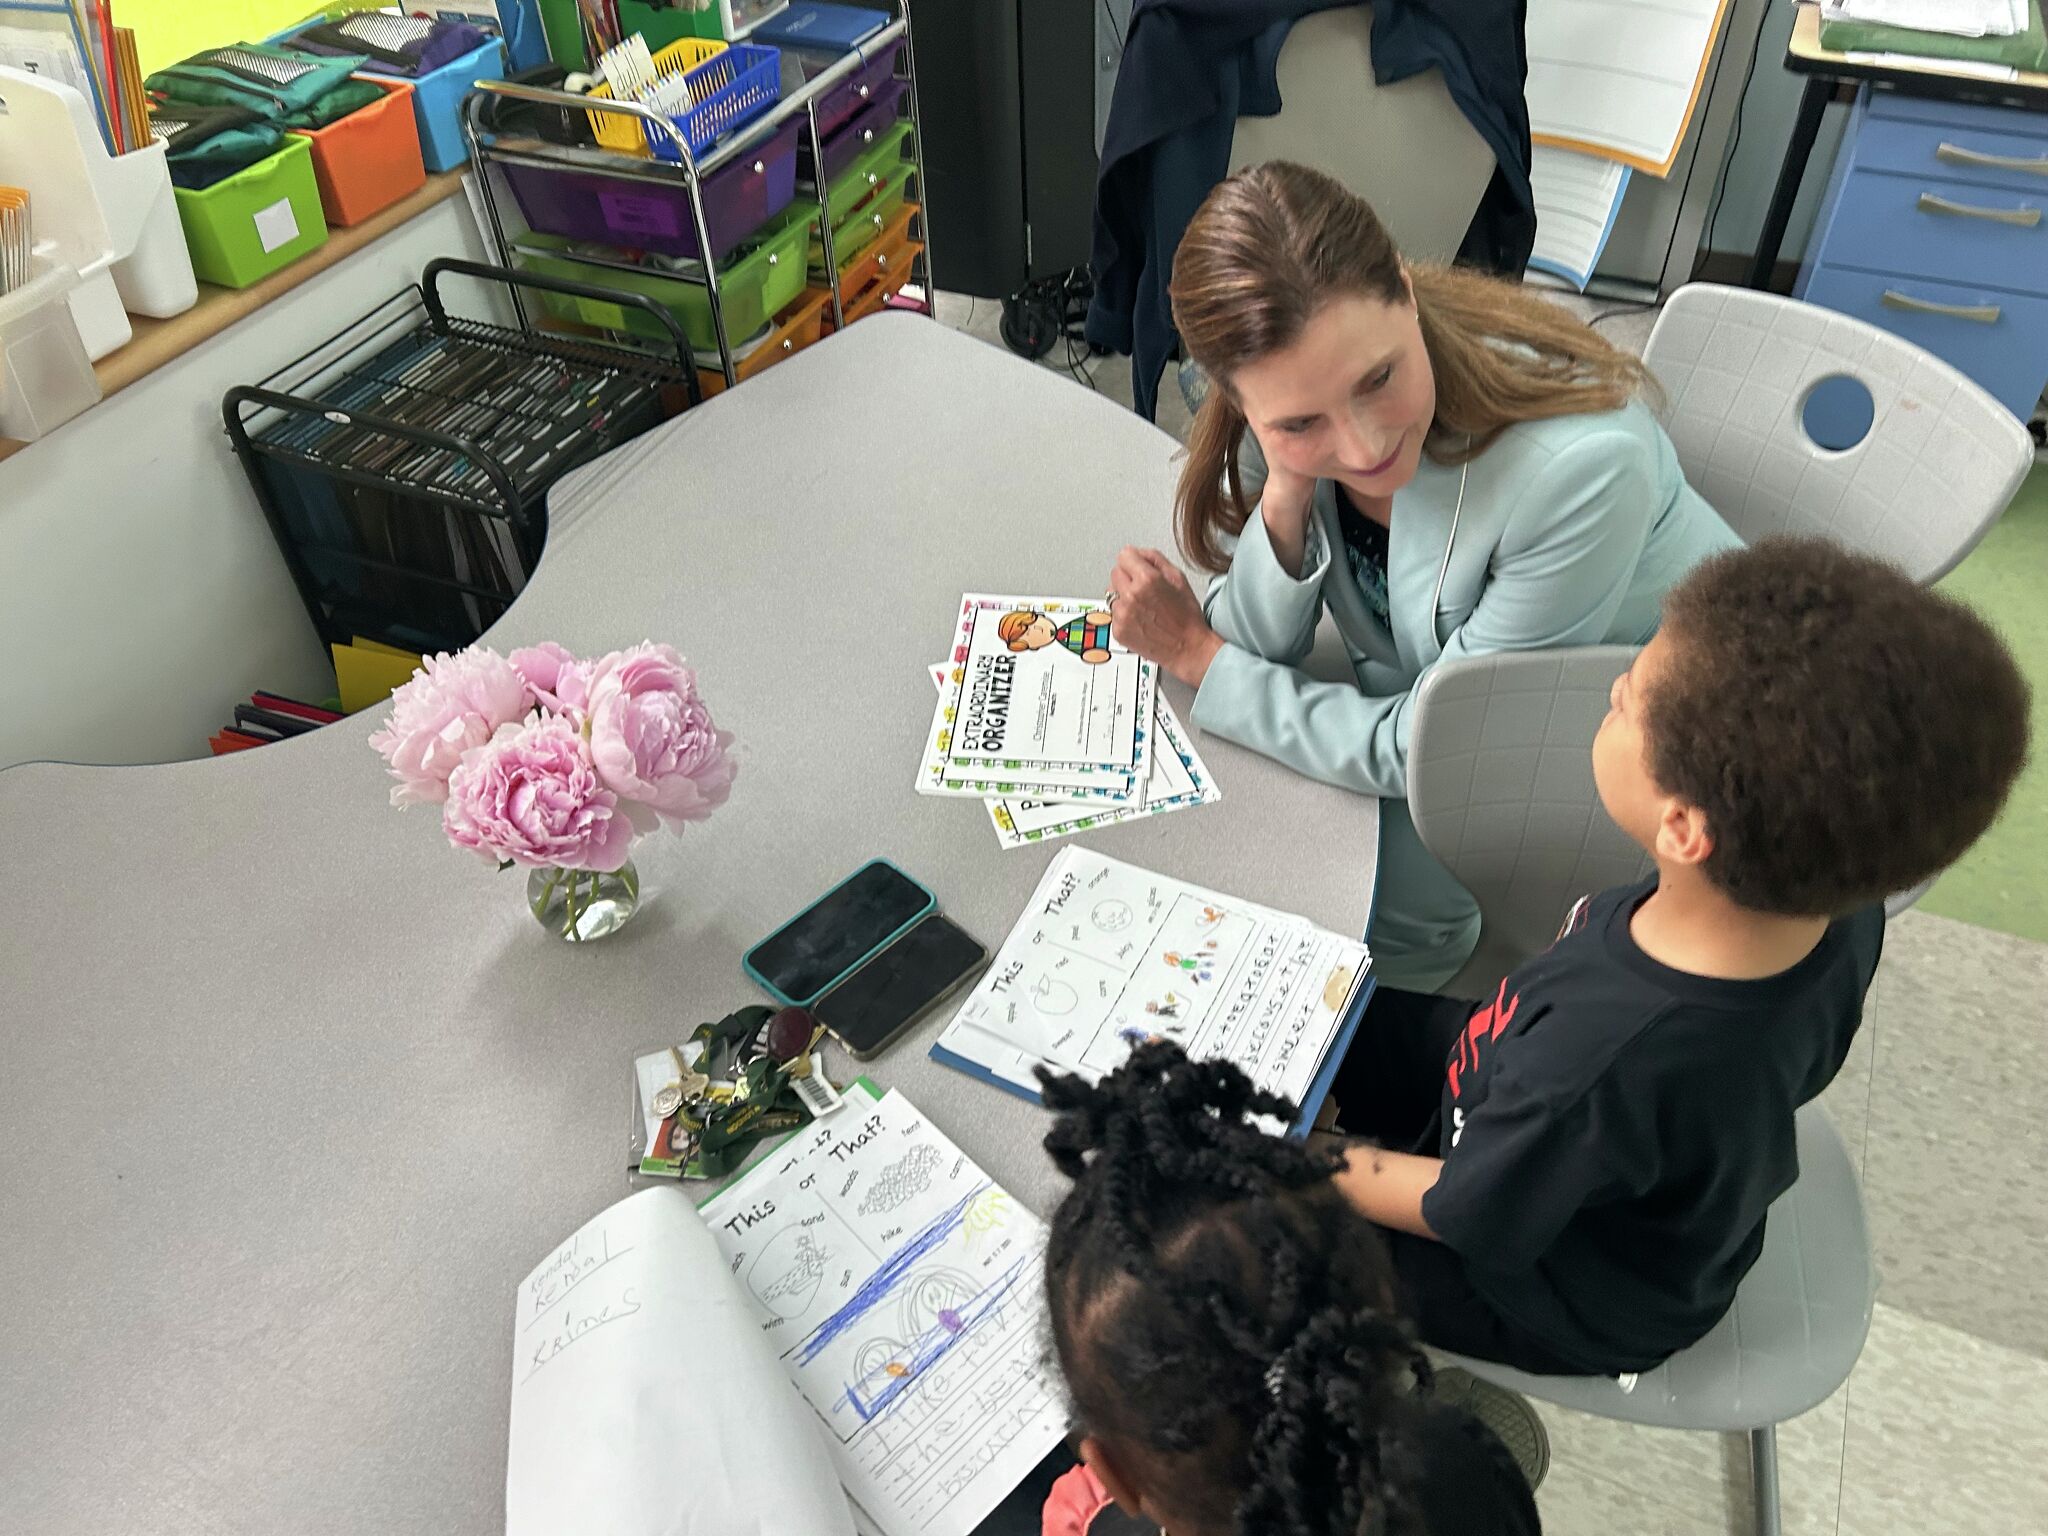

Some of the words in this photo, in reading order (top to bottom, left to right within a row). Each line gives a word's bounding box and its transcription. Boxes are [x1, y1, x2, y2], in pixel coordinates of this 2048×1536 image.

[963, 654, 994, 750] EXTRAORDINARY
[982, 654, 1017, 752] ORGANIZER
[990, 959, 1024, 994] This
[1032, 929, 1045, 945] or
[1043, 871, 1081, 916] That?
[900, 1120, 921, 1138] tent
[723, 1200, 776, 1236] This
[799, 1172, 817, 1190] or
[828, 1114, 887, 1163] That?
[800, 1210, 826, 1228] sand
[880, 1225, 905, 1244] hike
[761, 1316, 785, 1332] wim
